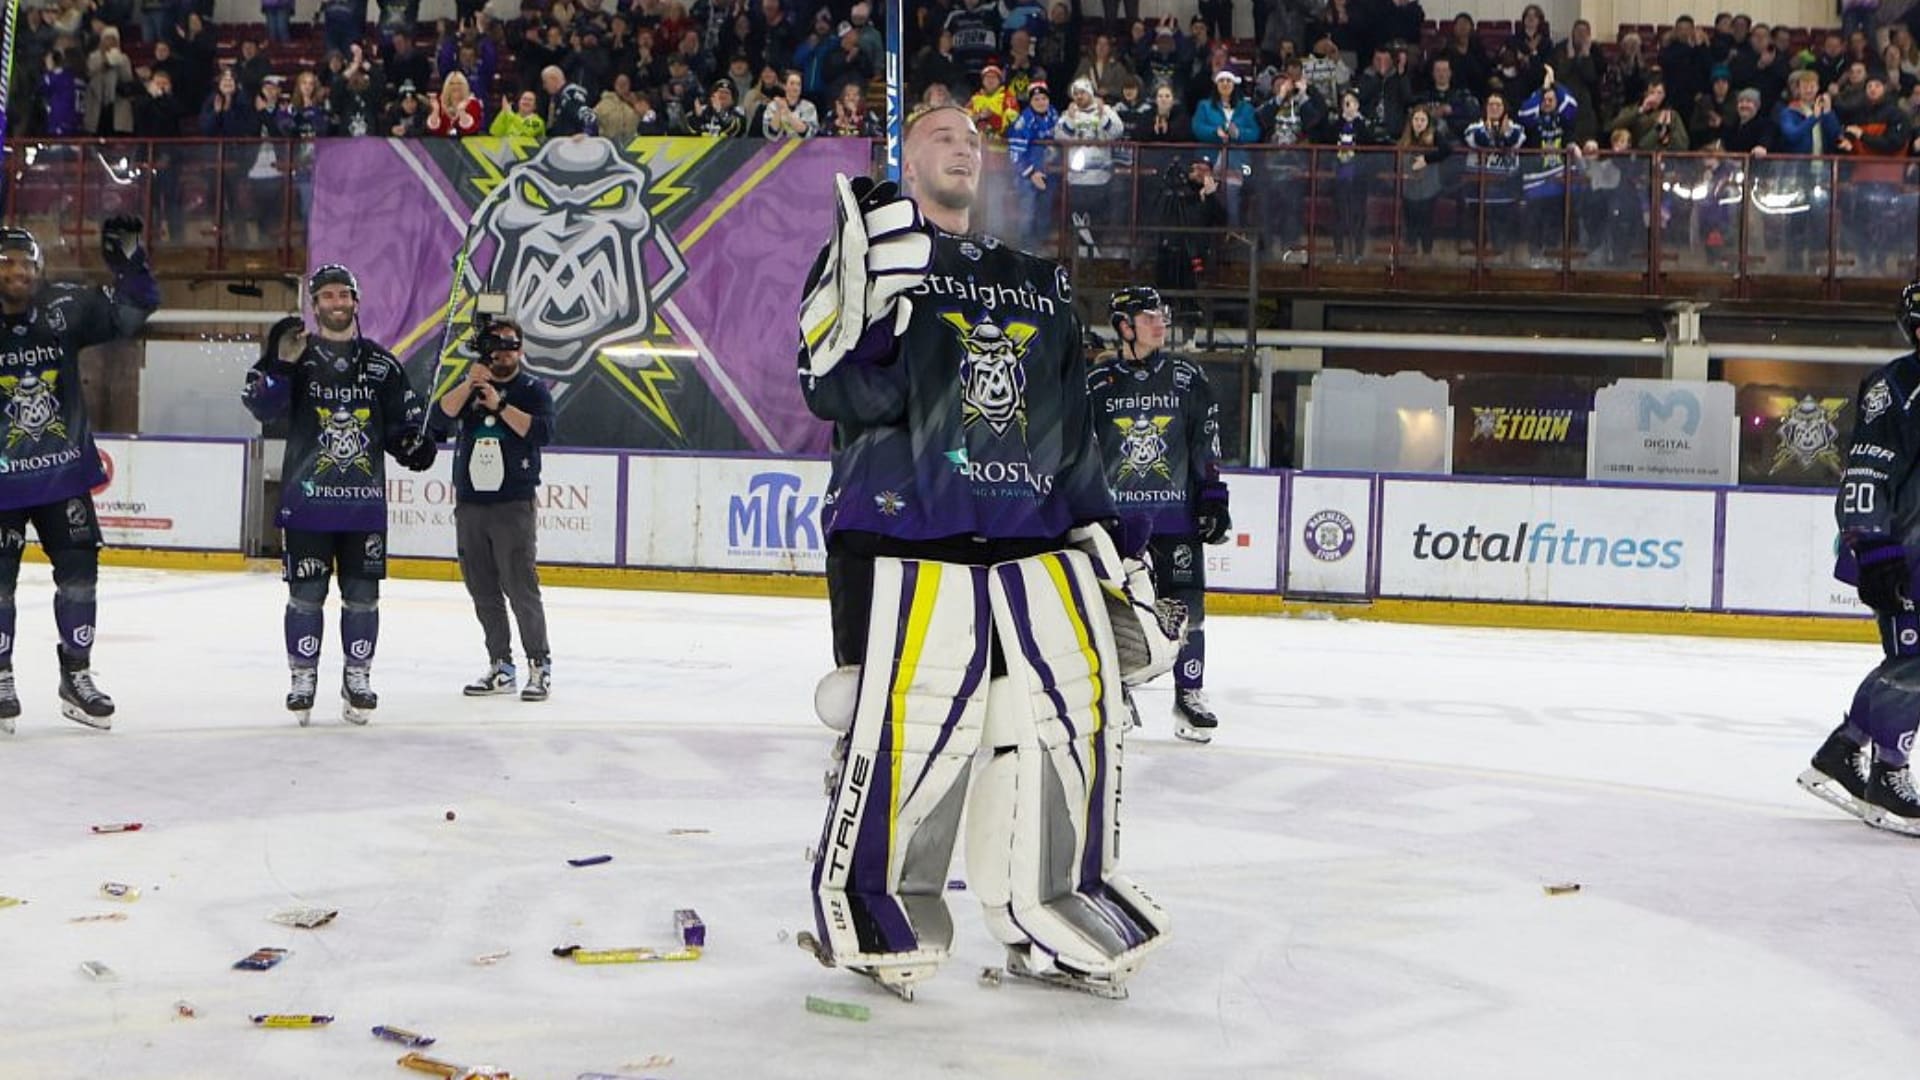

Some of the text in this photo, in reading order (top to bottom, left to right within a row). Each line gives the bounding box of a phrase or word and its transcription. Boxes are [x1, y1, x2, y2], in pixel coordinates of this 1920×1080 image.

[1494, 414, 1573, 442] STORM
[1643, 438, 1692, 450] DIGITAL
[728, 471, 820, 550] MTK
[1843, 482, 1875, 513] 20
[1412, 521, 1684, 570] totalfitness
[829, 753, 870, 882] TRUE
